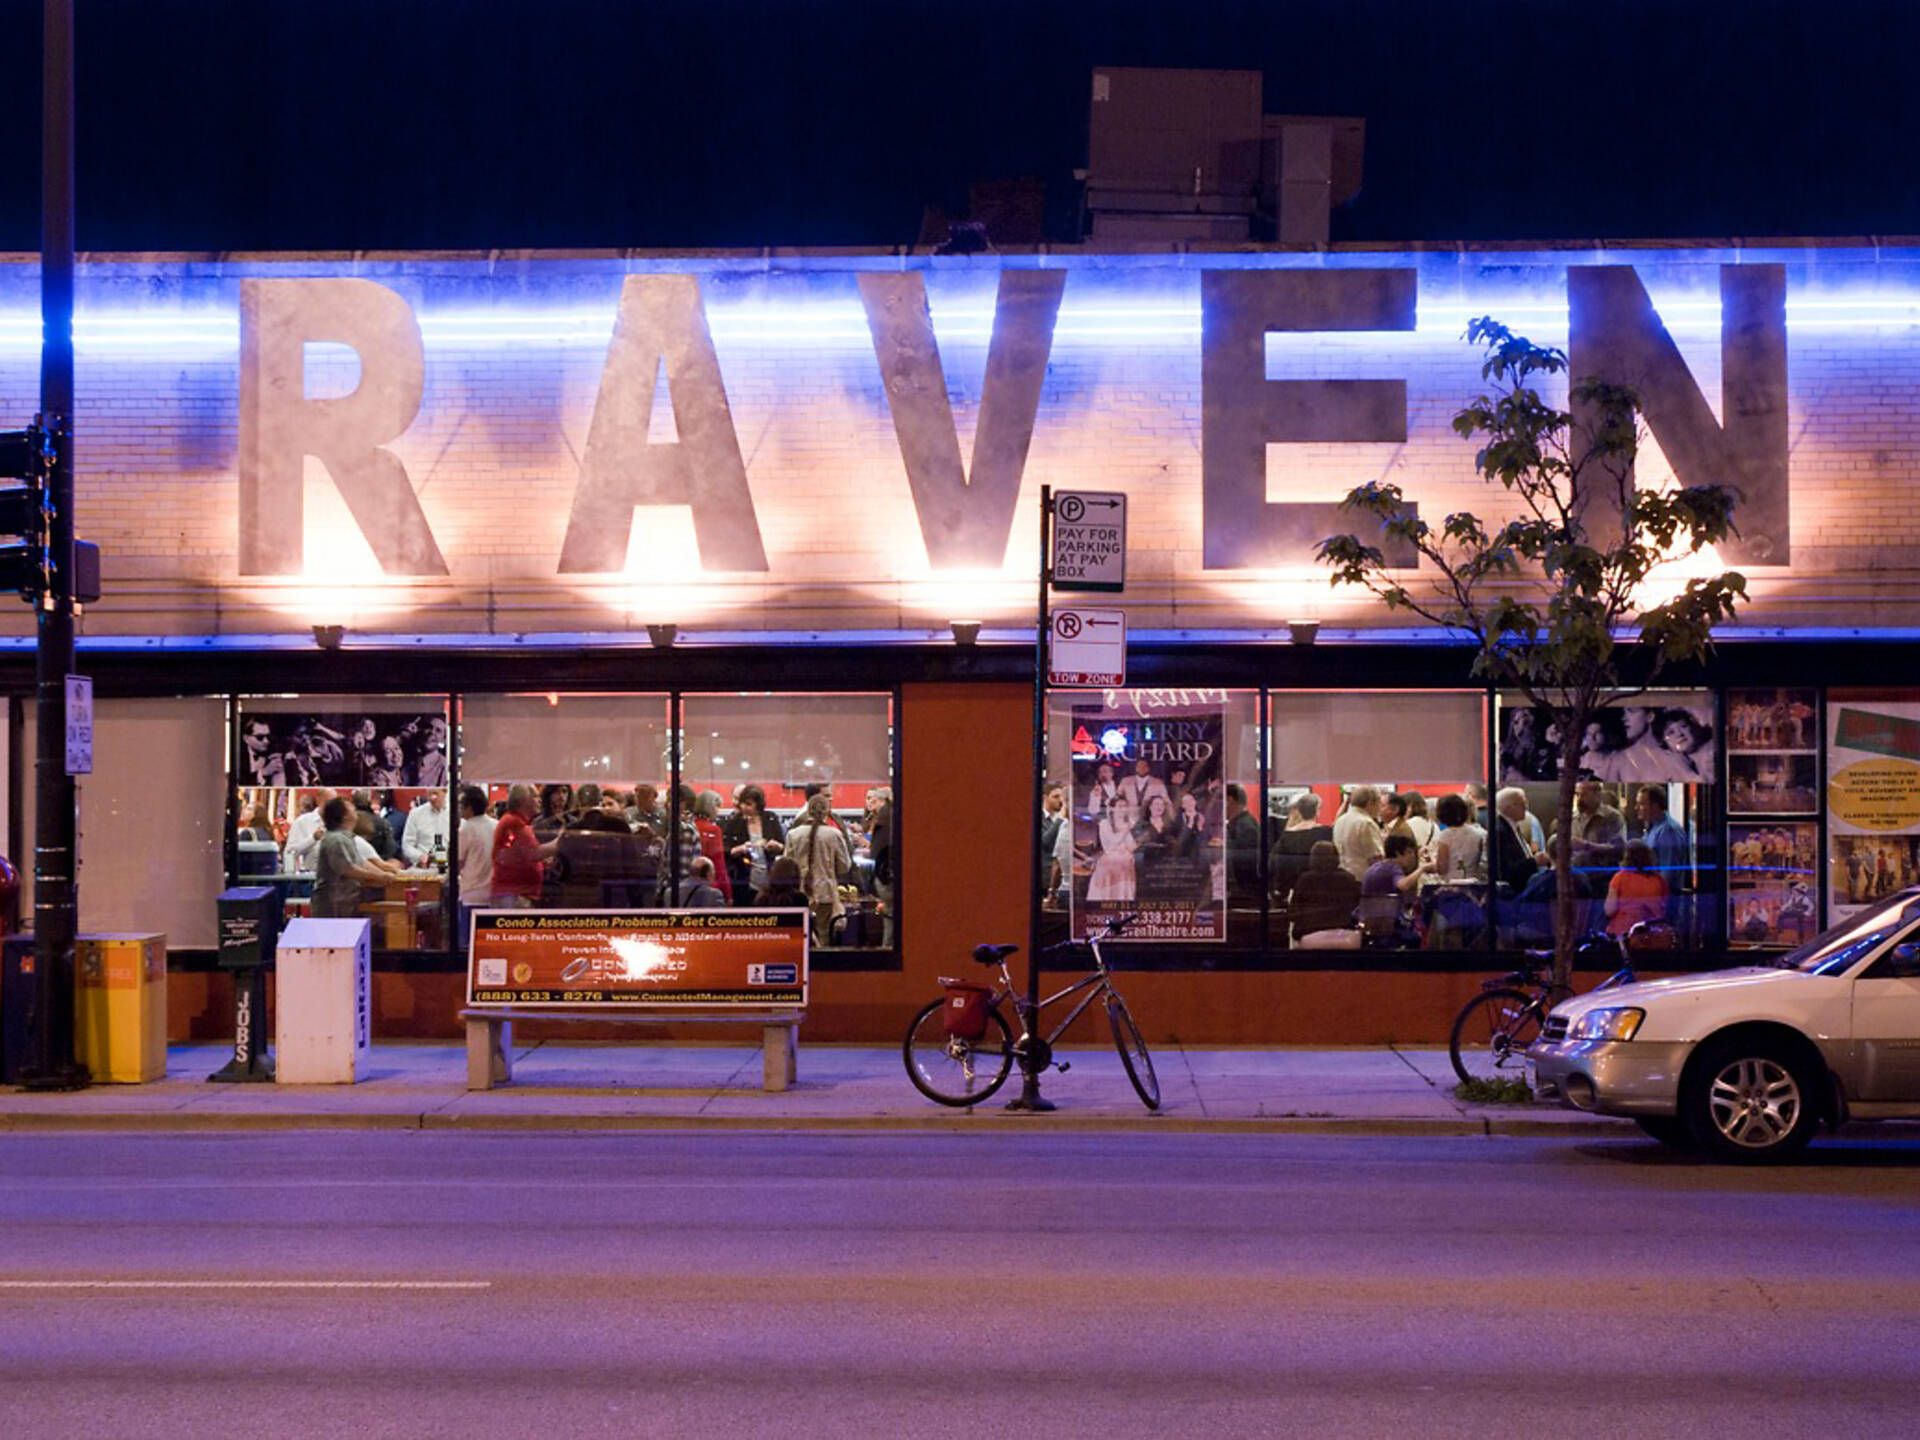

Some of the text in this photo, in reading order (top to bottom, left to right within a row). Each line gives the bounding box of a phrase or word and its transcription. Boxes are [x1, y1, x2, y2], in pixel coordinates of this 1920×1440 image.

[239, 264, 1791, 576] RAVEN
[1058, 528, 1118, 541] PAY FOR
[1058, 541, 1121, 554] PARKING
[1058, 553, 1108, 566] AT PAY
[1057, 566, 1086, 578] BOX
[1053, 672, 1117, 685] TOW ZONE
[496, 915, 779, 928] Condo Association Problems? Get Connected!
[486, 932, 500, 941] No
[502, 932, 556, 943] Long-Term
[662, 932, 673, 941] to
[724, 932, 790, 941] Associations
[476, 991, 517, 1002] (888)
[520, 992, 550, 1001] 633
[563, 991, 603, 1001] 8276
[612, 992, 801, 1003] www.ConnectedManagement.com
[236, 991, 250, 1063] JOBS
